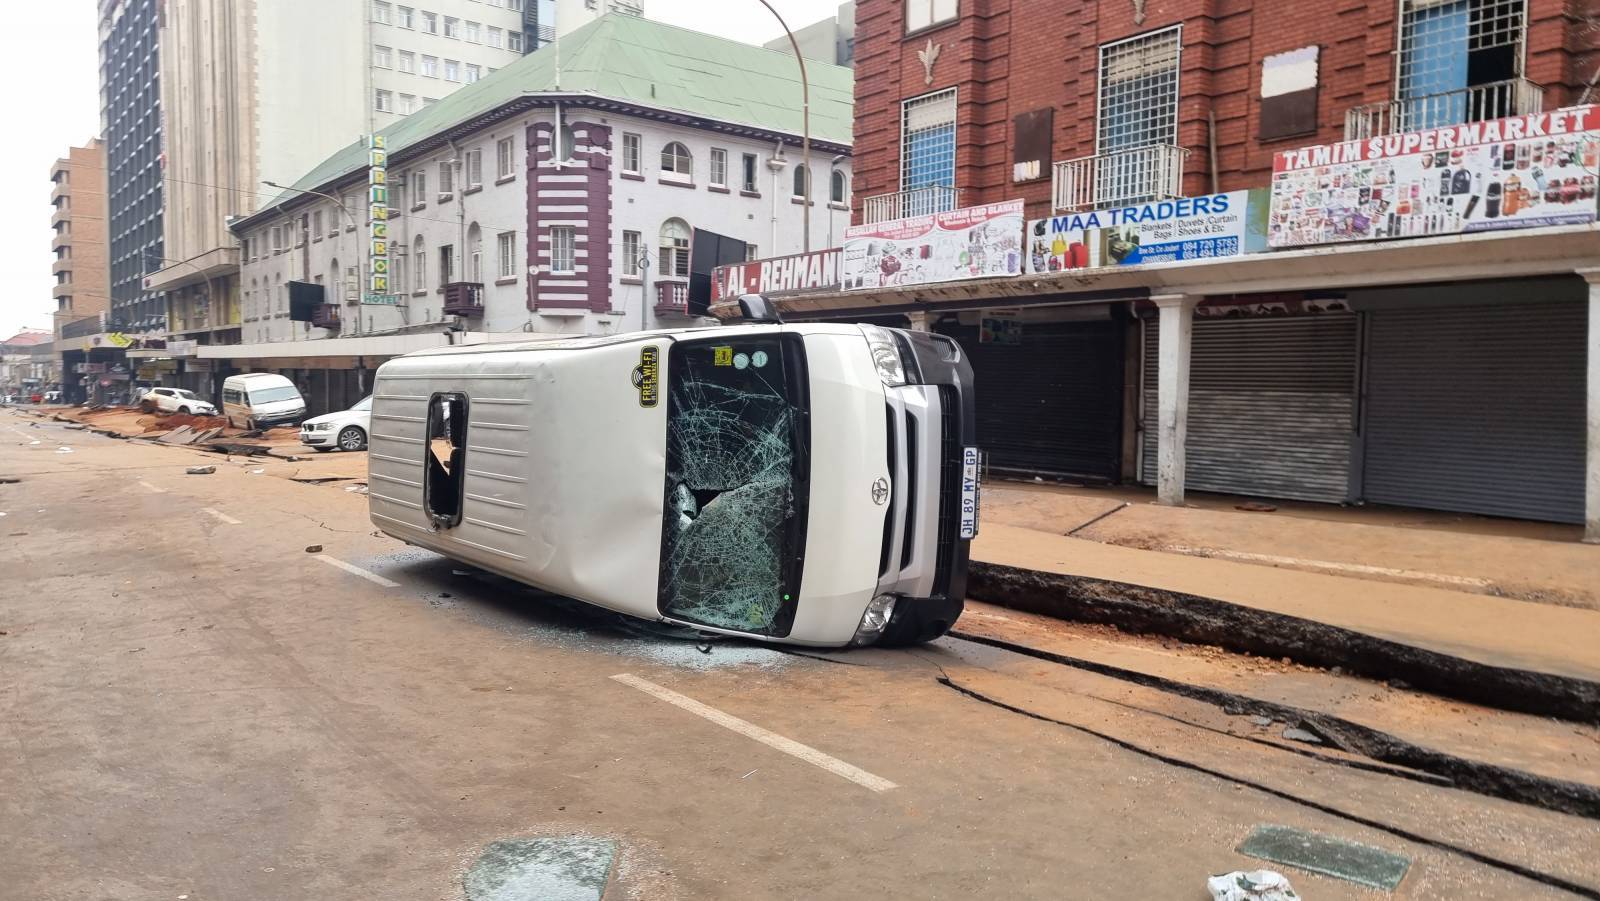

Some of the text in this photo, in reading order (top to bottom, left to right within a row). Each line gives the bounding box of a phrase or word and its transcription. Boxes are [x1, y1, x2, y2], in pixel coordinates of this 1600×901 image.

[1283, 109, 1591, 171] TAMIM SUPERMARKET
[373, 136, 388, 290] SPRINGBOK
[938, 208, 970, 222] CURTAIN
[970, 206, 987, 217] AND
[1052, 194, 1229, 234] MAA TRADERS
[1141, 221, 1172, 232] Blankets
[1178, 217, 1204, 228] Duvets
[1154, 229, 1172, 240] Bags
[1178, 226, 1202, 237] Shoes
[1212, 223, 1225, 233] Etc
[364, 293, 397, 304] HOTEL
[727, 266, 747, 298] AL
[642, 351, 652, 401] FREE WI-FI
[962, 450, 976, 534] JH 89 MY GP
